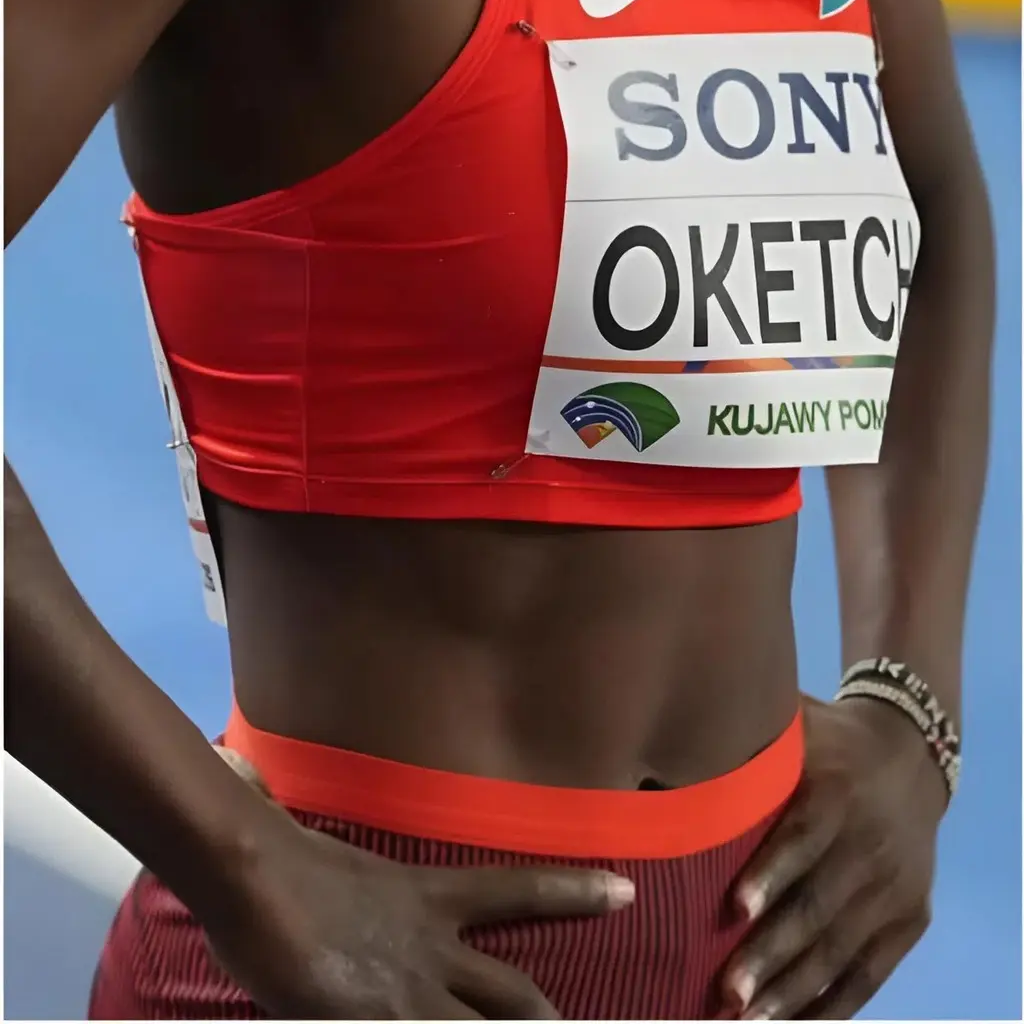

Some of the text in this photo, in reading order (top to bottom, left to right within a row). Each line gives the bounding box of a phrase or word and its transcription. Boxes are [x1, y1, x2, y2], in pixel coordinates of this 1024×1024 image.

[606, 67, 888, 162] SONY
[592, 215, 914, 352] OKETCH
[706, 400, 834, 437] KUJAWY
